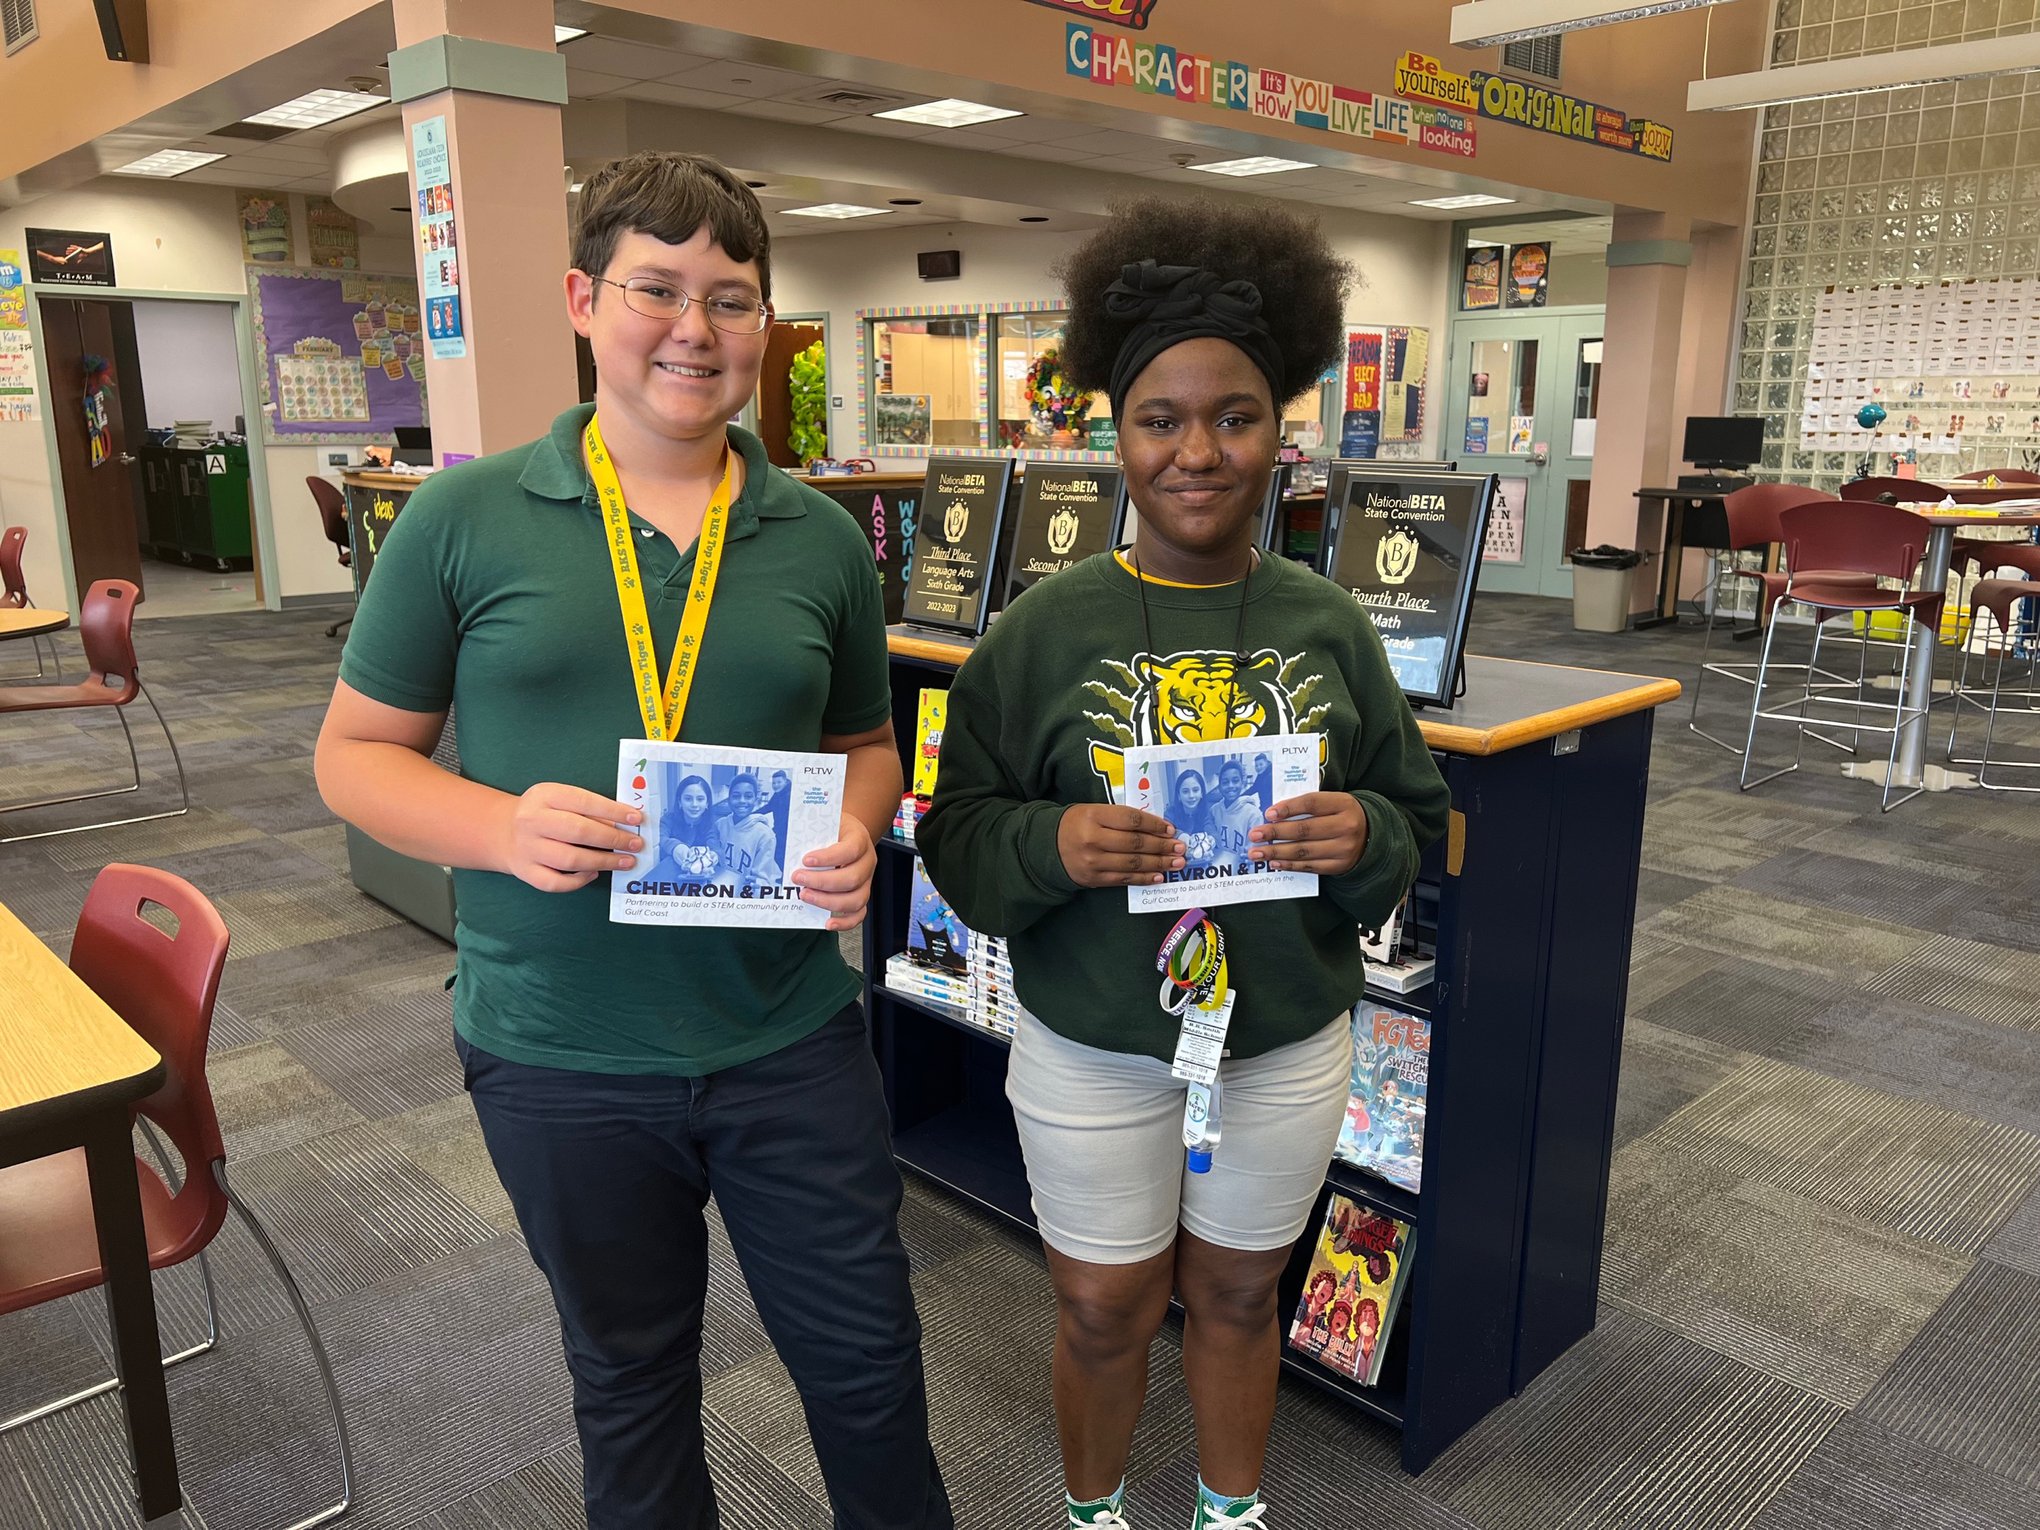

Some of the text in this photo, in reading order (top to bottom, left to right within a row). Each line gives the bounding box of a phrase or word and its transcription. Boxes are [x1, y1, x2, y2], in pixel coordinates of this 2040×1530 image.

[1069, 30, 1246, 103] CHARACTER
[1408, 53, 1438, 75] Be
[1265, 73, 1283, 92] It's
[1398, 68, 1471, 106] yourself.
[1255, 78, 1408, 135] HOW YOU LIVE LIFE
[1413, 109, 1435, 125] when
[1423, 130, 1474, 155] looking.
[1354, 365, 1376, 383] ELECT
[209, 455, 225, 473] A
[938, 484, 985, 495] State Convention
[1039, 492, 1098, 502] State Convention
[1364, 507, 1445, 522] State Convention
[609, 499, 631, 573] RKS Top Tiger
[699, 517, 720, 587] RKS Top Tiger
[930, 546, 972, 561] Third Place
[922, 562, 974, 579] Language Arts
[1027, 557, 1060, 571] Second
[926, 578, 965, 592] Sixth Grade
[926, 600, 957, 613] 2022-2023
[1351, 587, 1430, 610] Fourth Place
[1369, 612, 1401, 630] Math
[1380, 633, 1416, 650] Grade
[637, 640, 657, 722] RKS Top Tiger
[664, 651, 691, 731] RKS Top Tiger
[1281, 746, 1309, 755] PLTW
[803, 766, 833, 775] PLTW
[1237, 863, 1249, 876] &
[626, 880, 734, 899] CHEVRON
[739, 886, 754, 899] &
[1141, 887, 1178, 897] Partnering
[1188, 882, 1206, 892] build
[1214, 880, 1234, 889] STEM
[1235, 876, 1273, 887] community
[1282, 874, 1295, 882] the
[625, 898, 668, 909] Partnering
[681, 900, 702, 908] build
[711, 901, 735, 910] STEM
[736, 902, 780, 911] community
[790, 903, 804, 911] the
[1141, 895, 1179, 906] Gulf Coast
[625, 908, 669, 918] Gulf Coast
[1201, 961, 1220, 987] YOUR
[1413, 1055, 1427, 1063] THE
